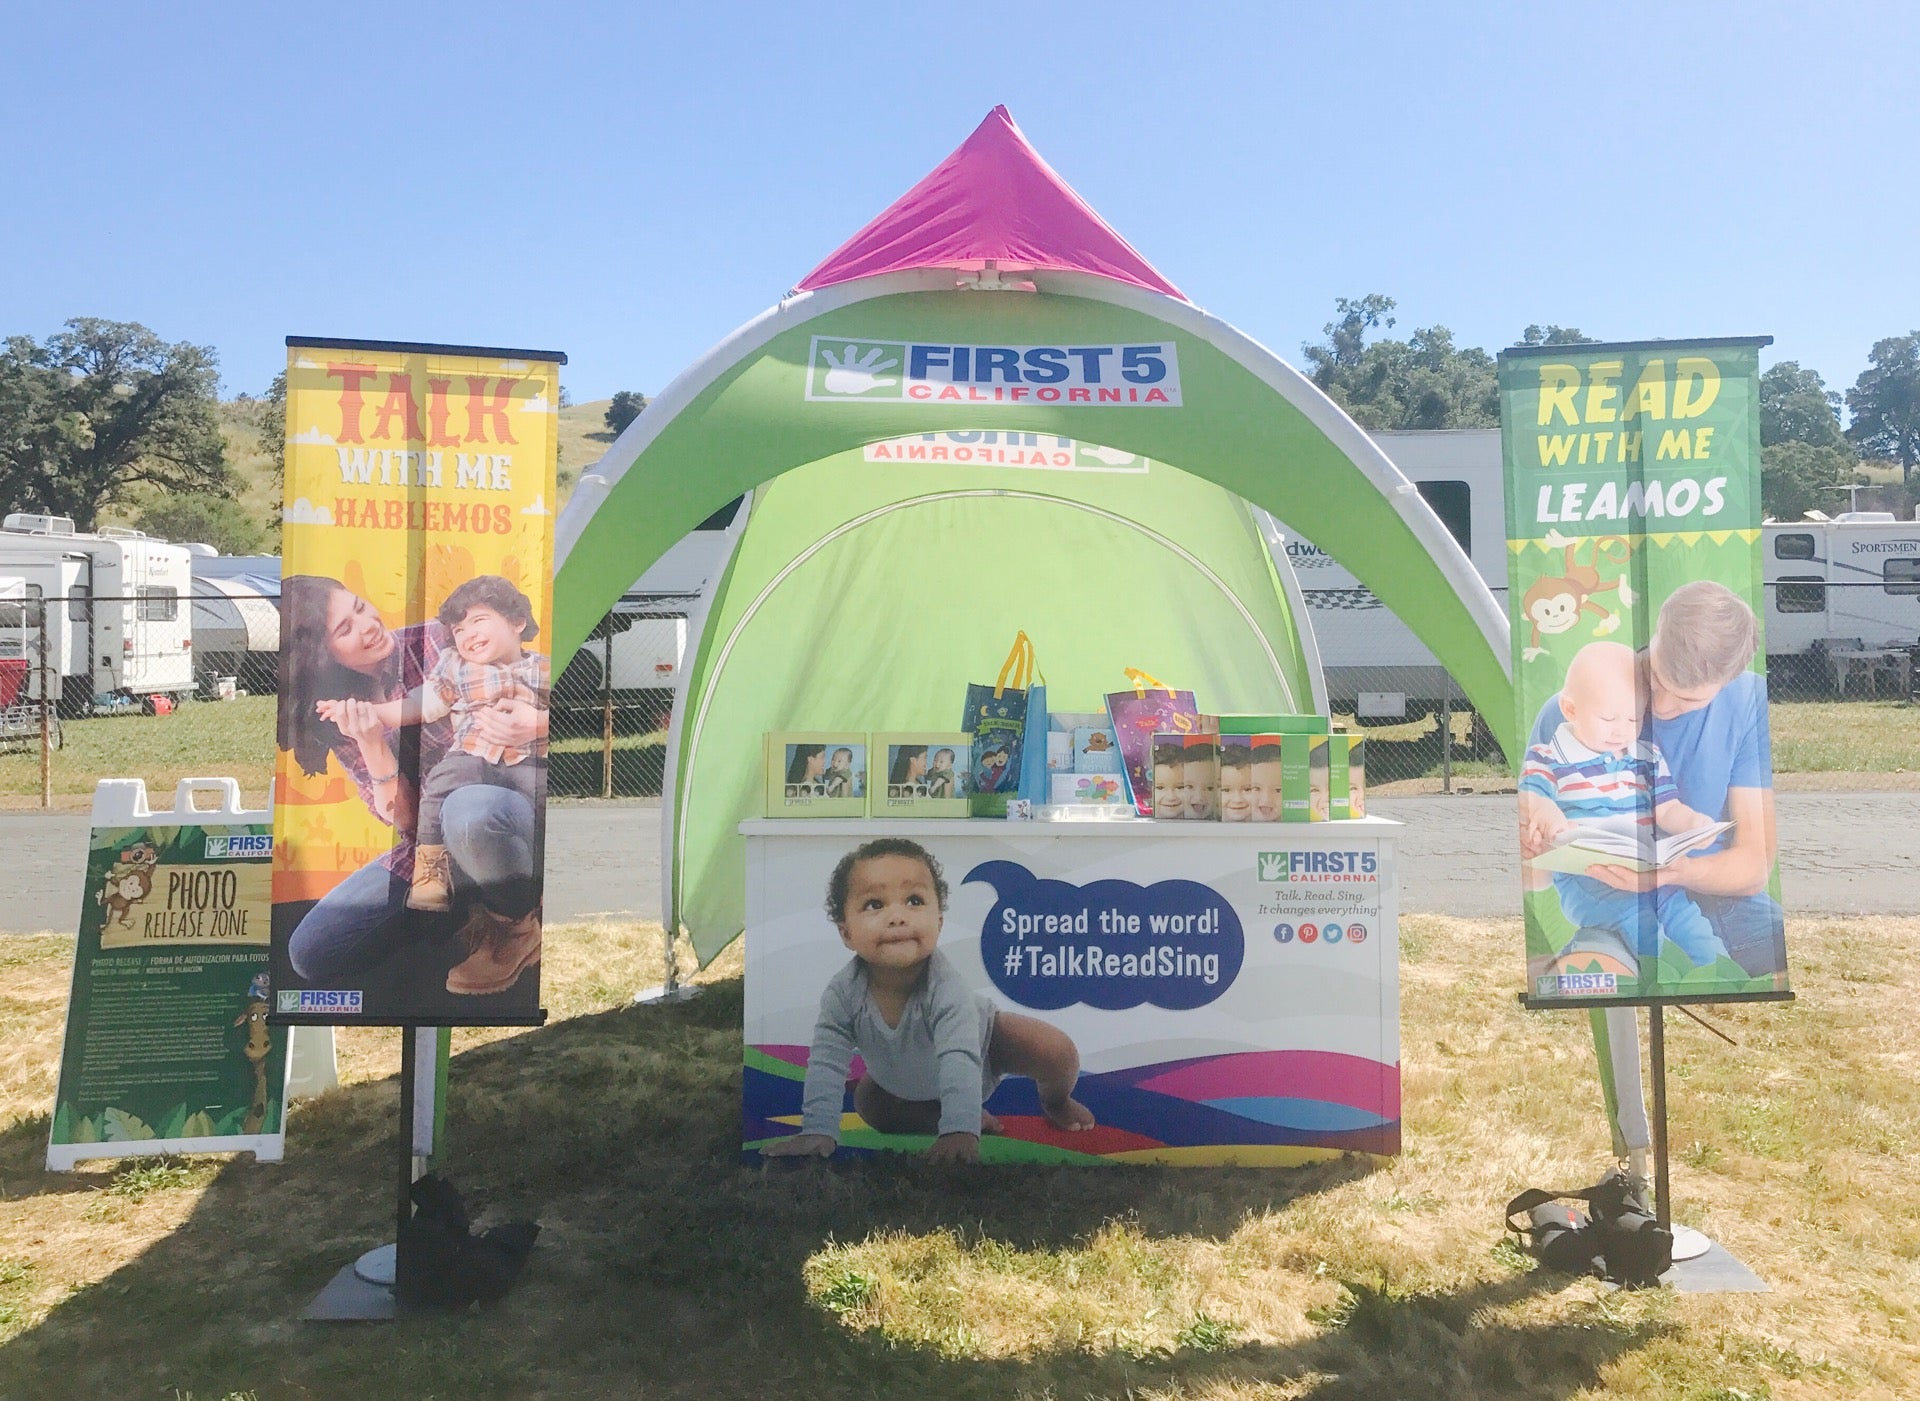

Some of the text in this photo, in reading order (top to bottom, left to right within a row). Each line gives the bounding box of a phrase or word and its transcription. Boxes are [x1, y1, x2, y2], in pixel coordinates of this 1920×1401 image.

[909, 345, 1167, 384] FIRST 5
[326, 361, 519, 448] TALK
[908, 385, 1169, 402] CALIFORNIA
[1537, 357, 1721, 426] READ
[1537, 427, 1714, 467] WITH ME
[336, 447, 512, 491] WITH ME
[1536, 477, 1727, 523] LEAMOS
[333, 497, 512, 535] HABLEMOS
[1851, 541, 1917, 554] SPORTSMEN
[229, 836, 273, 850] FIRST
[1290, 851, 1377, 873] FIRST 5
[167, 869, 237, 910] PHOTO
[1290, 874, 1377, 882] CALIFORNIA
[1258, 904, 1267, 914] It
[1270, 904, 1318, 917] changes
[1275, 889, 1365, 903] Talk. Read. Sing.
[144, 909, 249, 939] RELEASE ZONE
[1001, 908, 1219, 940] Spread the word!
[151, 955, 172, 965] FORMA
[174, 955, 183, 964] DE
[231, 953, 248, 963] PARA
[249, 953, 270, 962] FOTOS
[1003, 945, 1219, 985] #TalkReadSing
[1557, 973, 1615, 989] FIRST 5
[300, 991, 360, 1005] FIRST 5
